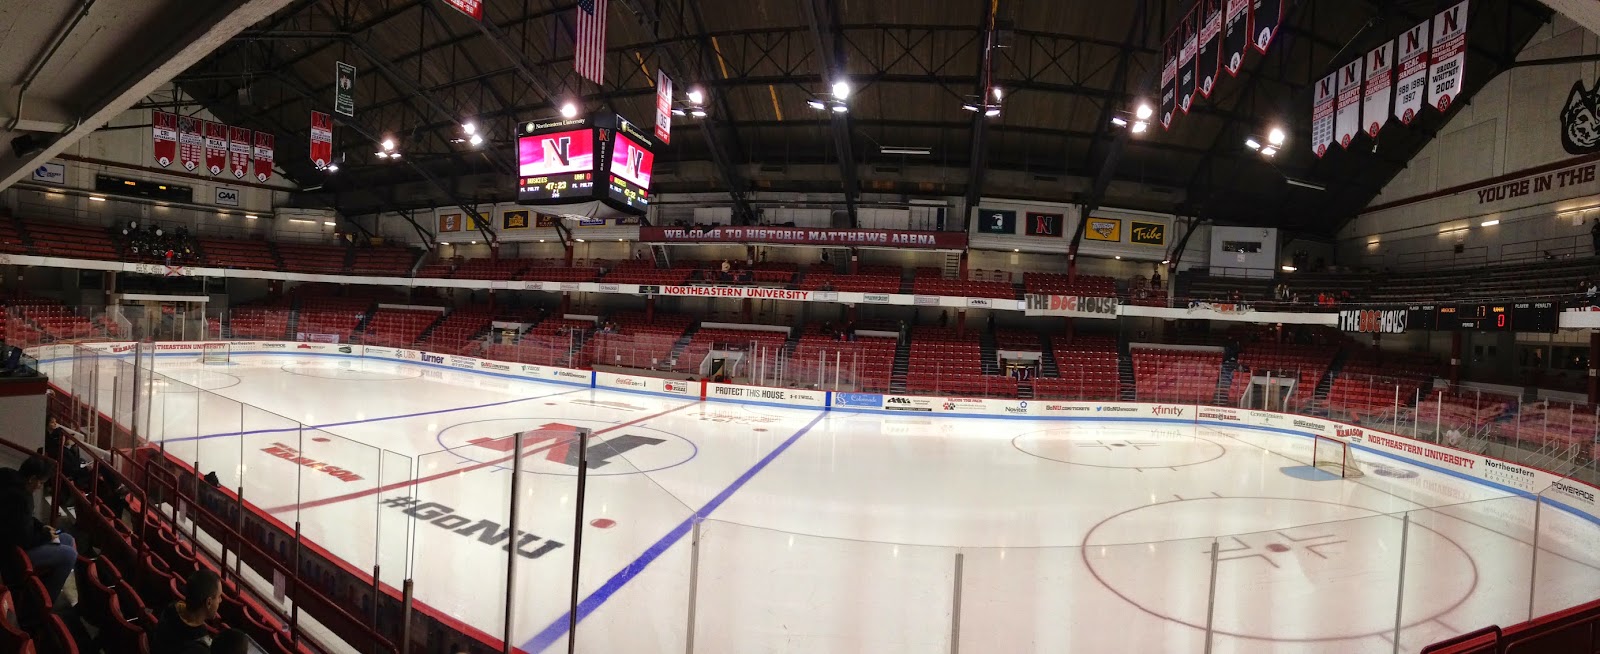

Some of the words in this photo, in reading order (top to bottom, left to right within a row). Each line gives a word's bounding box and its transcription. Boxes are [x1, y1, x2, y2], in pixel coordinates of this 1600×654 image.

[1443, 6, 1459, 36] N
[1406, 26, 1420, 54] N
[1373, 46, 1386, 71] N
[1404, 57, 1419, 70] ECAC
[1437, 60, 1457, 74] BROOKE
[1345, 63, 1355, 86] N
[1432, 66, 1459, 83] WHITNEY
[1320, 77, 1330, 98] N
[1436, 79, 1455, 94] 2002
[1402, 91, 1416, 104] 1997
[599, 128, 610, 141] N
[542, 137, 570, 168] N
[627, 145, 643, 179] N
[546, 181, 567, 190] 47:23
[1478, 180, 1530, 204] YOU'RE
[1534, 175, 1552, 193] IN
[1557, 165, 1596, 187] THE
[218, 192, 236, 200] CAA
[1036, 216, 1052, 234] N
[1133, 226, 1161, 241] Tribe
[664, 229, 721, 239] WELCOME
[726, 230, 741, 238] TO
[747, 229, 804, 240] HISTORIC
[808, 231, 887, 243] MATTHEWS
[892, 234, 936, 244] ARENA
[664, 286, 742, 297] NORTHEASTERN
[747, 288, 809, 300] UNIVERSITY
[1026, 295, 1048, 310] THE
[1051, 295, 1076, 310] DOG
[1077, 296, 1117, 315] HOUSE
[1340, 310, 1360, 331] THE
[1359, 309, 1381, 332] DOG
[1498, 314, 1505, 327] 0
[420, 352, 444, 364] Turner
[716, 387, 744, 396] PROTECT
[746, 389, 760, 397] THIS
[762, 390, 786, 399] HOUSE.
[1152, 405, 1183, 416] xfinity
[1368, 434, 1423, 456] NORTHEASTERN
[1425, 449, 1475, 469] UNIVERSITY
[1485, 459, 1535, 478] Northeastern
[1552, 481, 1595, 502] POWERADE
[378, 496, 565, 560] #GoNU
